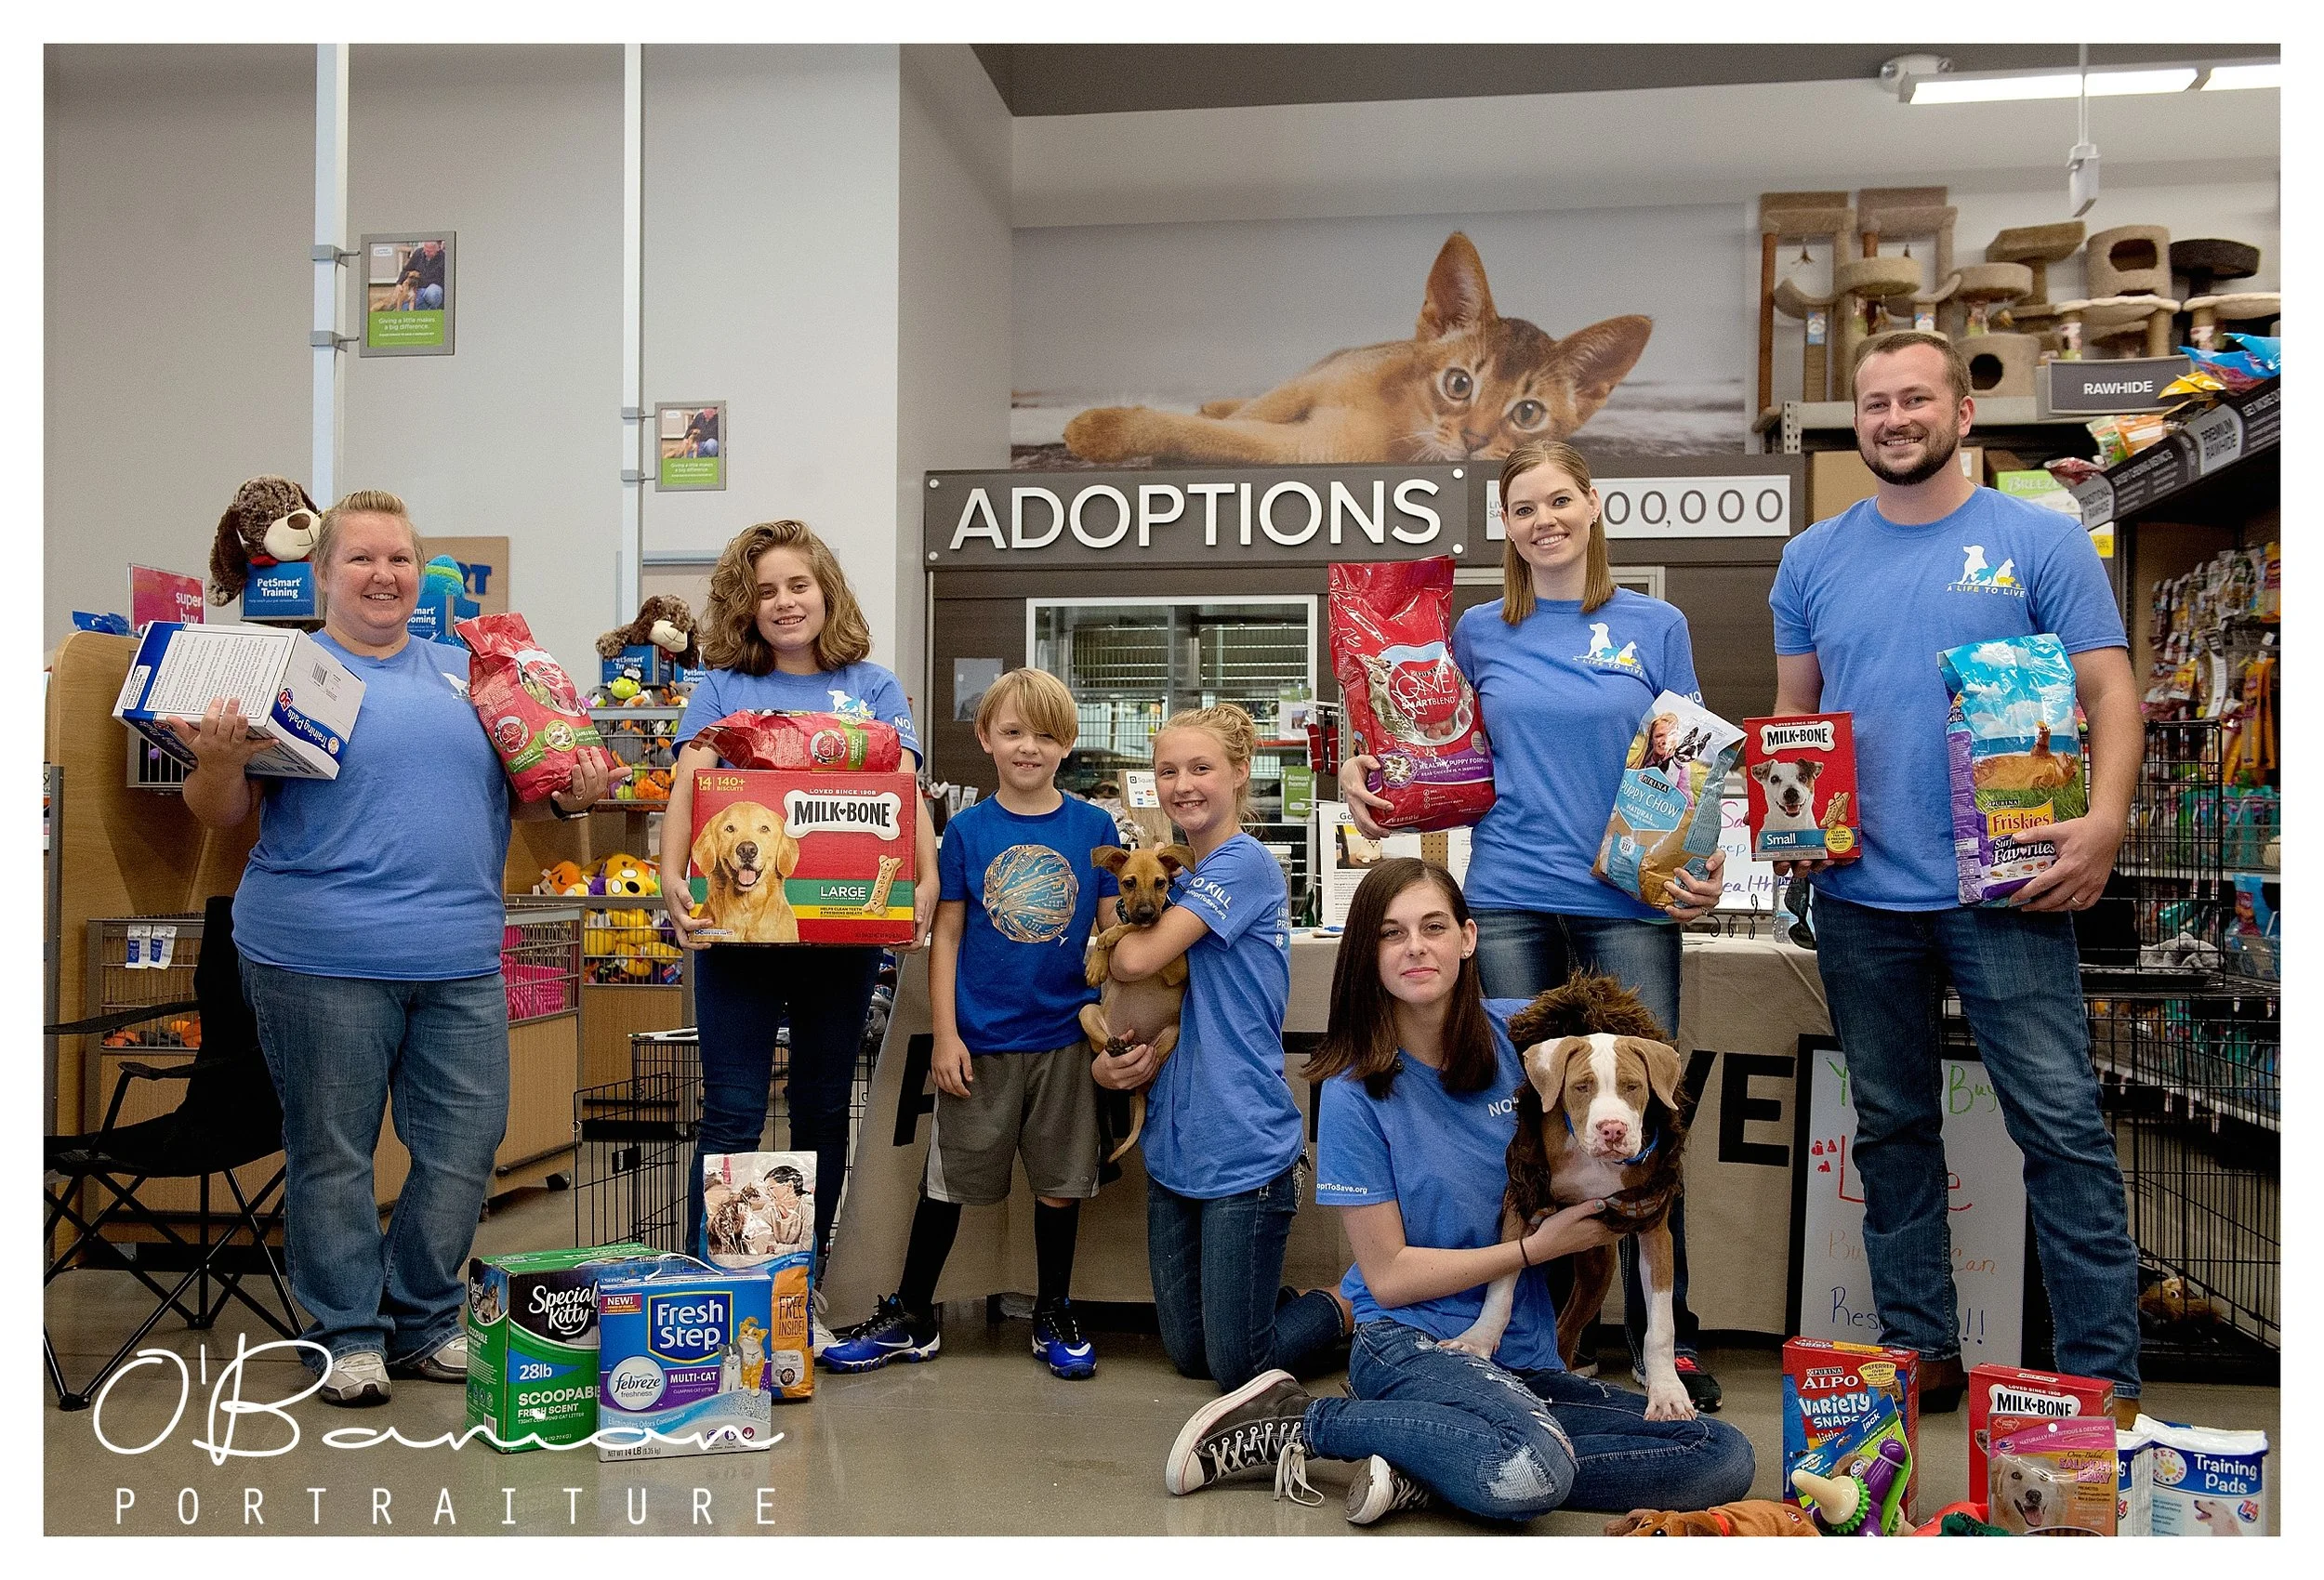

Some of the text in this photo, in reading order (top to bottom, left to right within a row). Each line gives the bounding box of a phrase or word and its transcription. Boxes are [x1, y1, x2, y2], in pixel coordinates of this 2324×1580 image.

[2083, 380, 2154, 395] RAWHIDE
[949, 479, 1441, 550] ADOPTIONS
[257, 577, 301, 587] PetSmart
[176, 591, 202, 610] super
[261, 587, 298, 599] Training
[2002, 587, 2026, 598] LIVE
[1625, 665, 1644, 678] LIVE
[279, 690, 293, 712] 50
[287, 709, 328, 748] Training Pads
[894, 717, 911, 729] NO
[698, 776, 746, 786] 14 140+
[1642, 774, 1668, 792] PURINA
[1621, 780, 1683, 818] PUPPY CHOW
[1626, 803, 1654, 822] NATURAL
[1992, 812, 2050, 833] Friskies
[1766, 833, 1796, 845] Small
[820, 886, 866, 898] LARGE
[1205, 881, 1234, 910] KILL
[1316, 1183, 1367, 1195] optToSave.org
[529, 1280, 601, 1314] Special
[607, 1297, 634, 1306] NEW!
[656, 1299, 724, 1326] Fresh
[779, 1296, 805, 1321] FREE
[548, 1305, 589, 1336] Kitty
[778, 1320, 805, 1337] INSIDE!
[519, 1363, 553, 1380] 28lb
[669, 1371, 717, 1384] MULTI-CAT
[614, 1371, 661, 1393] febreze
[1802, 1375, 1859, 1390] ALPO
[518, 1385, 598, 1407] SCOOPAB
[548, 1402, 579, 1414] SCENT
[607, 1412, 686, 1429] Eliminates Odors Continuously
[1862, 1412, 1881, 1433] jack
[2019, 1435, 2048, 1444] NATURALLY
[2048, 1429, 2079, 1439] NUTRITIOUS
[2082, 1425, 2110, 1433] DELICIOUS
[608, 1449, 616, 1457] NET
[616, 1448, 624, 1456] WT
[625, 1447, 632, 1456] 14
[633, 1446, 642, 1455] LB
[2058, 1457, 2112, 1472] SALMON
[2194, 1454, 2258, 1481] Training
[2074, 1470, 2112, 1485] JERKY
[2205, 1473, 2248, 1494] Pads
[2240, 1499, 2260, 1519] 14
